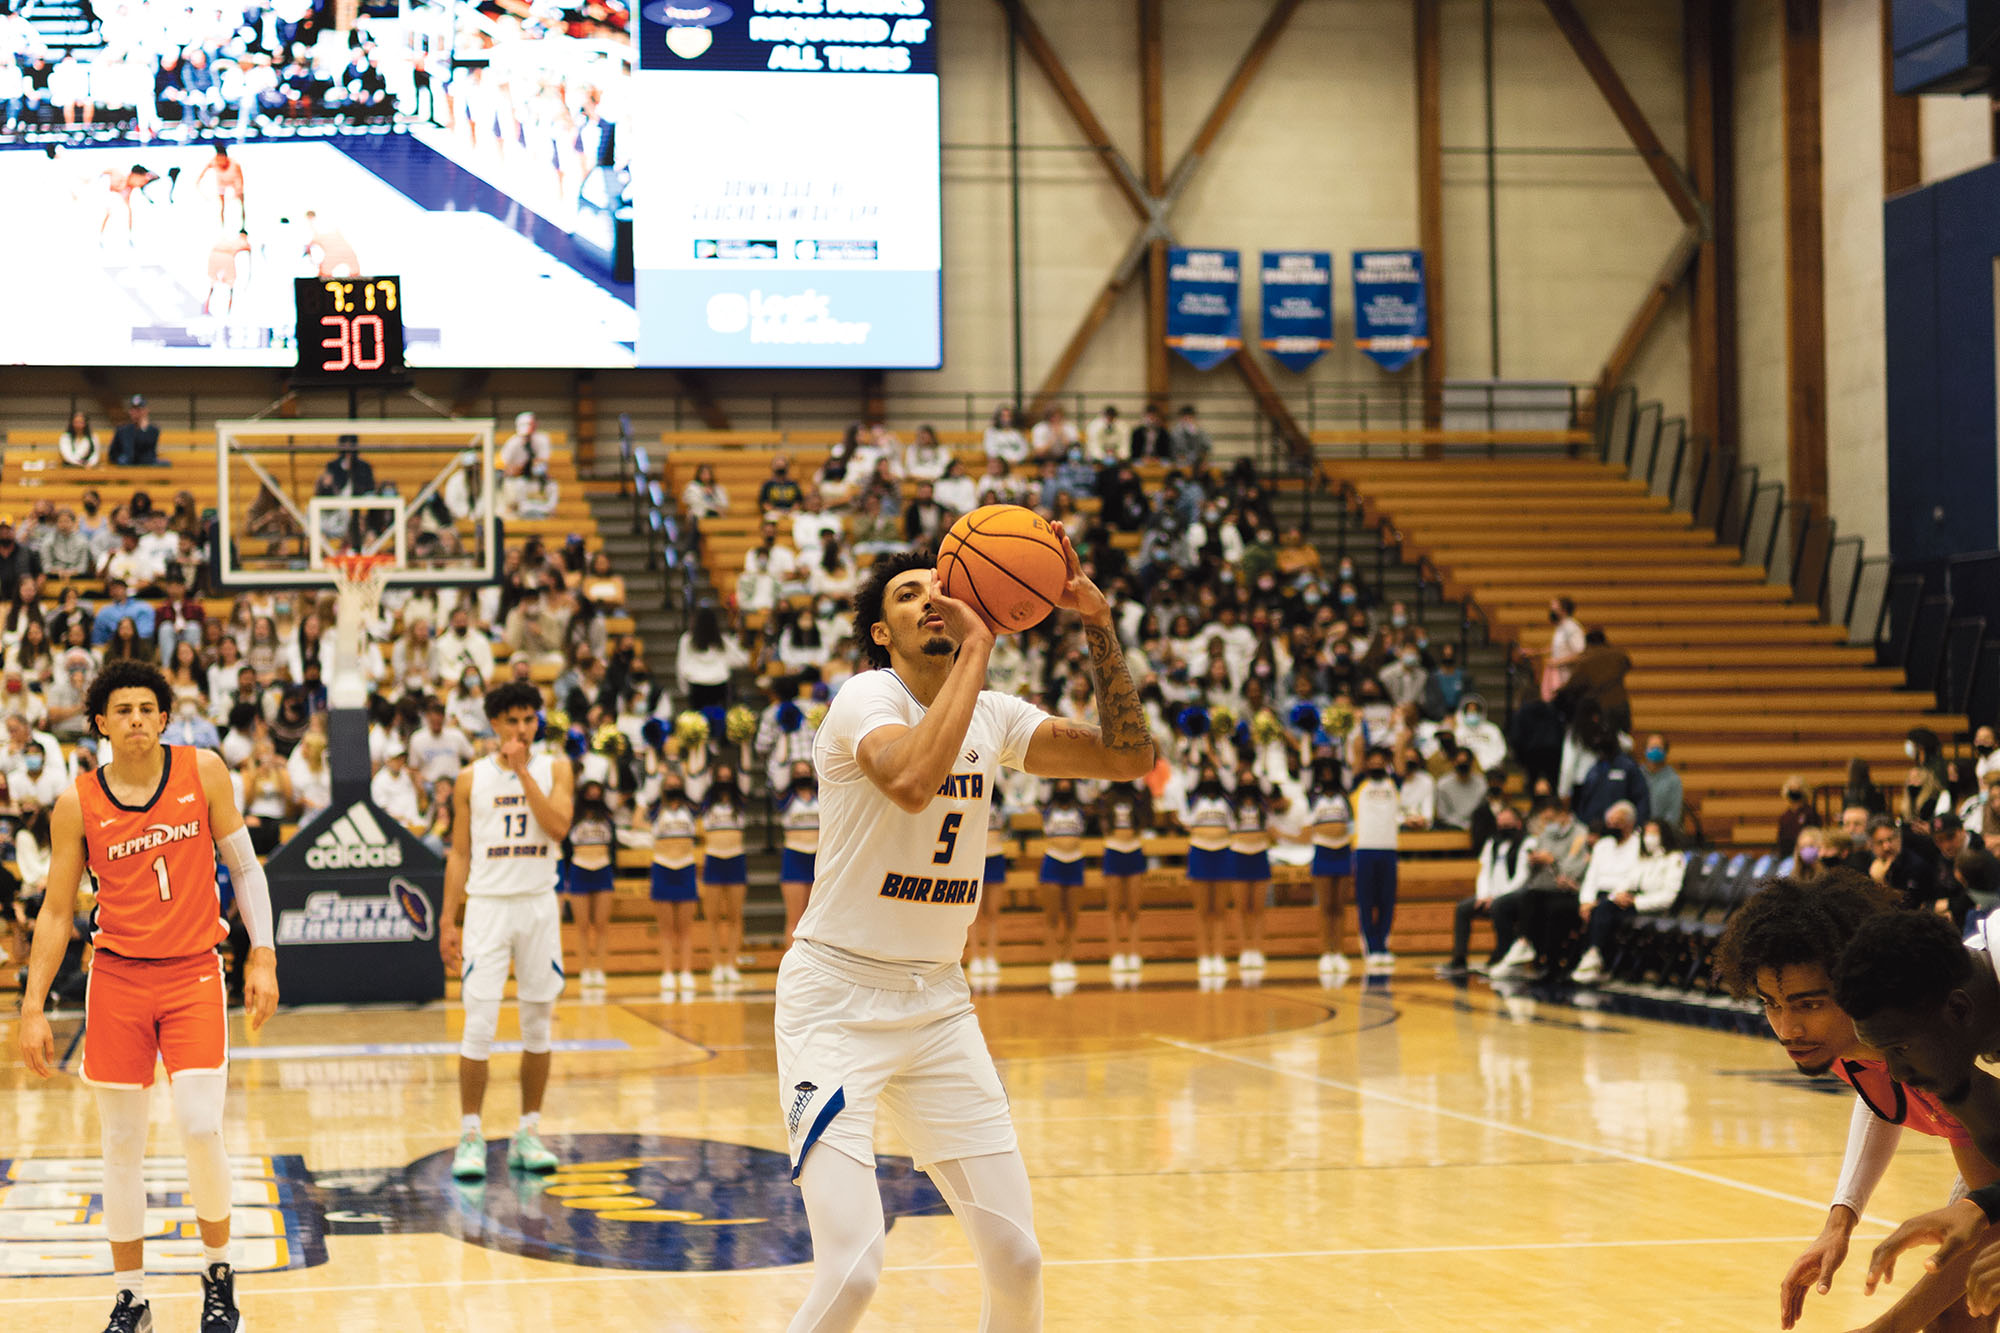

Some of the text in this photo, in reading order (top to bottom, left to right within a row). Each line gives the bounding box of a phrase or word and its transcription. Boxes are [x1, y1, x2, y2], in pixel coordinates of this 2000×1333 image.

[768, 45, 823, 69] ALL
[325, 280, 397, 312] 7:17
[320, 315, 385, 371] 30
[936, 772, 984, 800] ANTA
[493, 796, 526, 809] SANT
[107, 820, 200, 861] PEPPERDINE
[504, 812, 528, 839] 13
[931, 811, 965, 866] 5
[305, 843, 403, 870] adidas
[151, 855, 173, 902] 1
[878, 871, 980, 905] BARBARA
